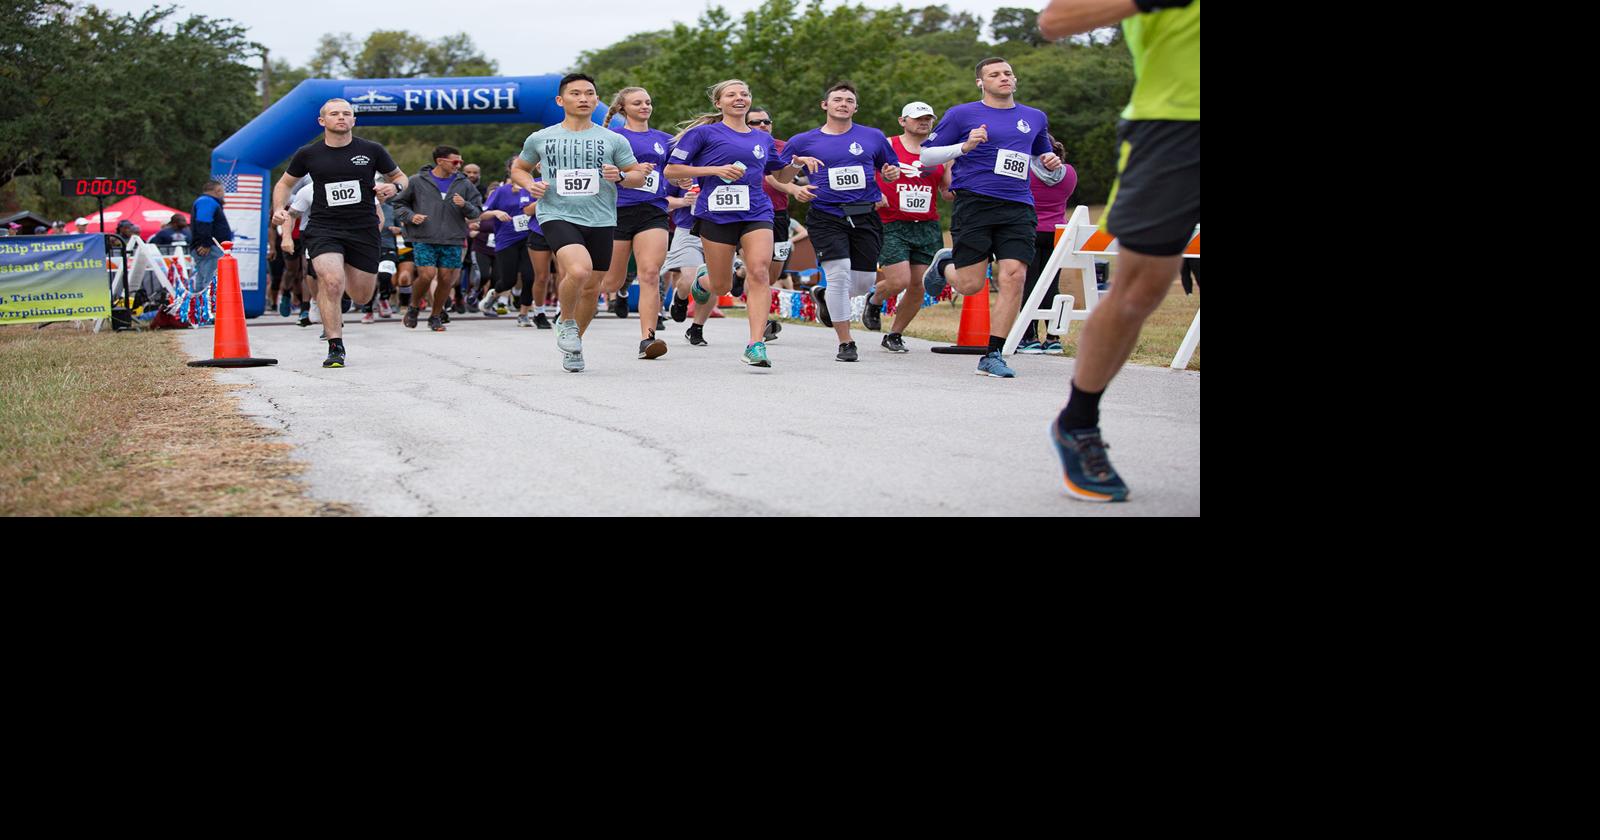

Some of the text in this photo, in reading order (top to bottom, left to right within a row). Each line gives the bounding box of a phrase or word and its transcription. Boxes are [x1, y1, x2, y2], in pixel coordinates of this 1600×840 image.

[403, 87, 517, 111] FINISH
[1003, 158, 1025, 173] 588
[564, 178, 591, 191] 597
[836, 173, 859, 186] 590
[331, 188, 356, 201] 902
[716, 193, 740, 206] 591
[906, 198, 926, 208] 502
[0, 241, 84, 255] Chip Timing
[43, 258, 103, 272] Results
[11, 292, 84, 302] Triathlons
